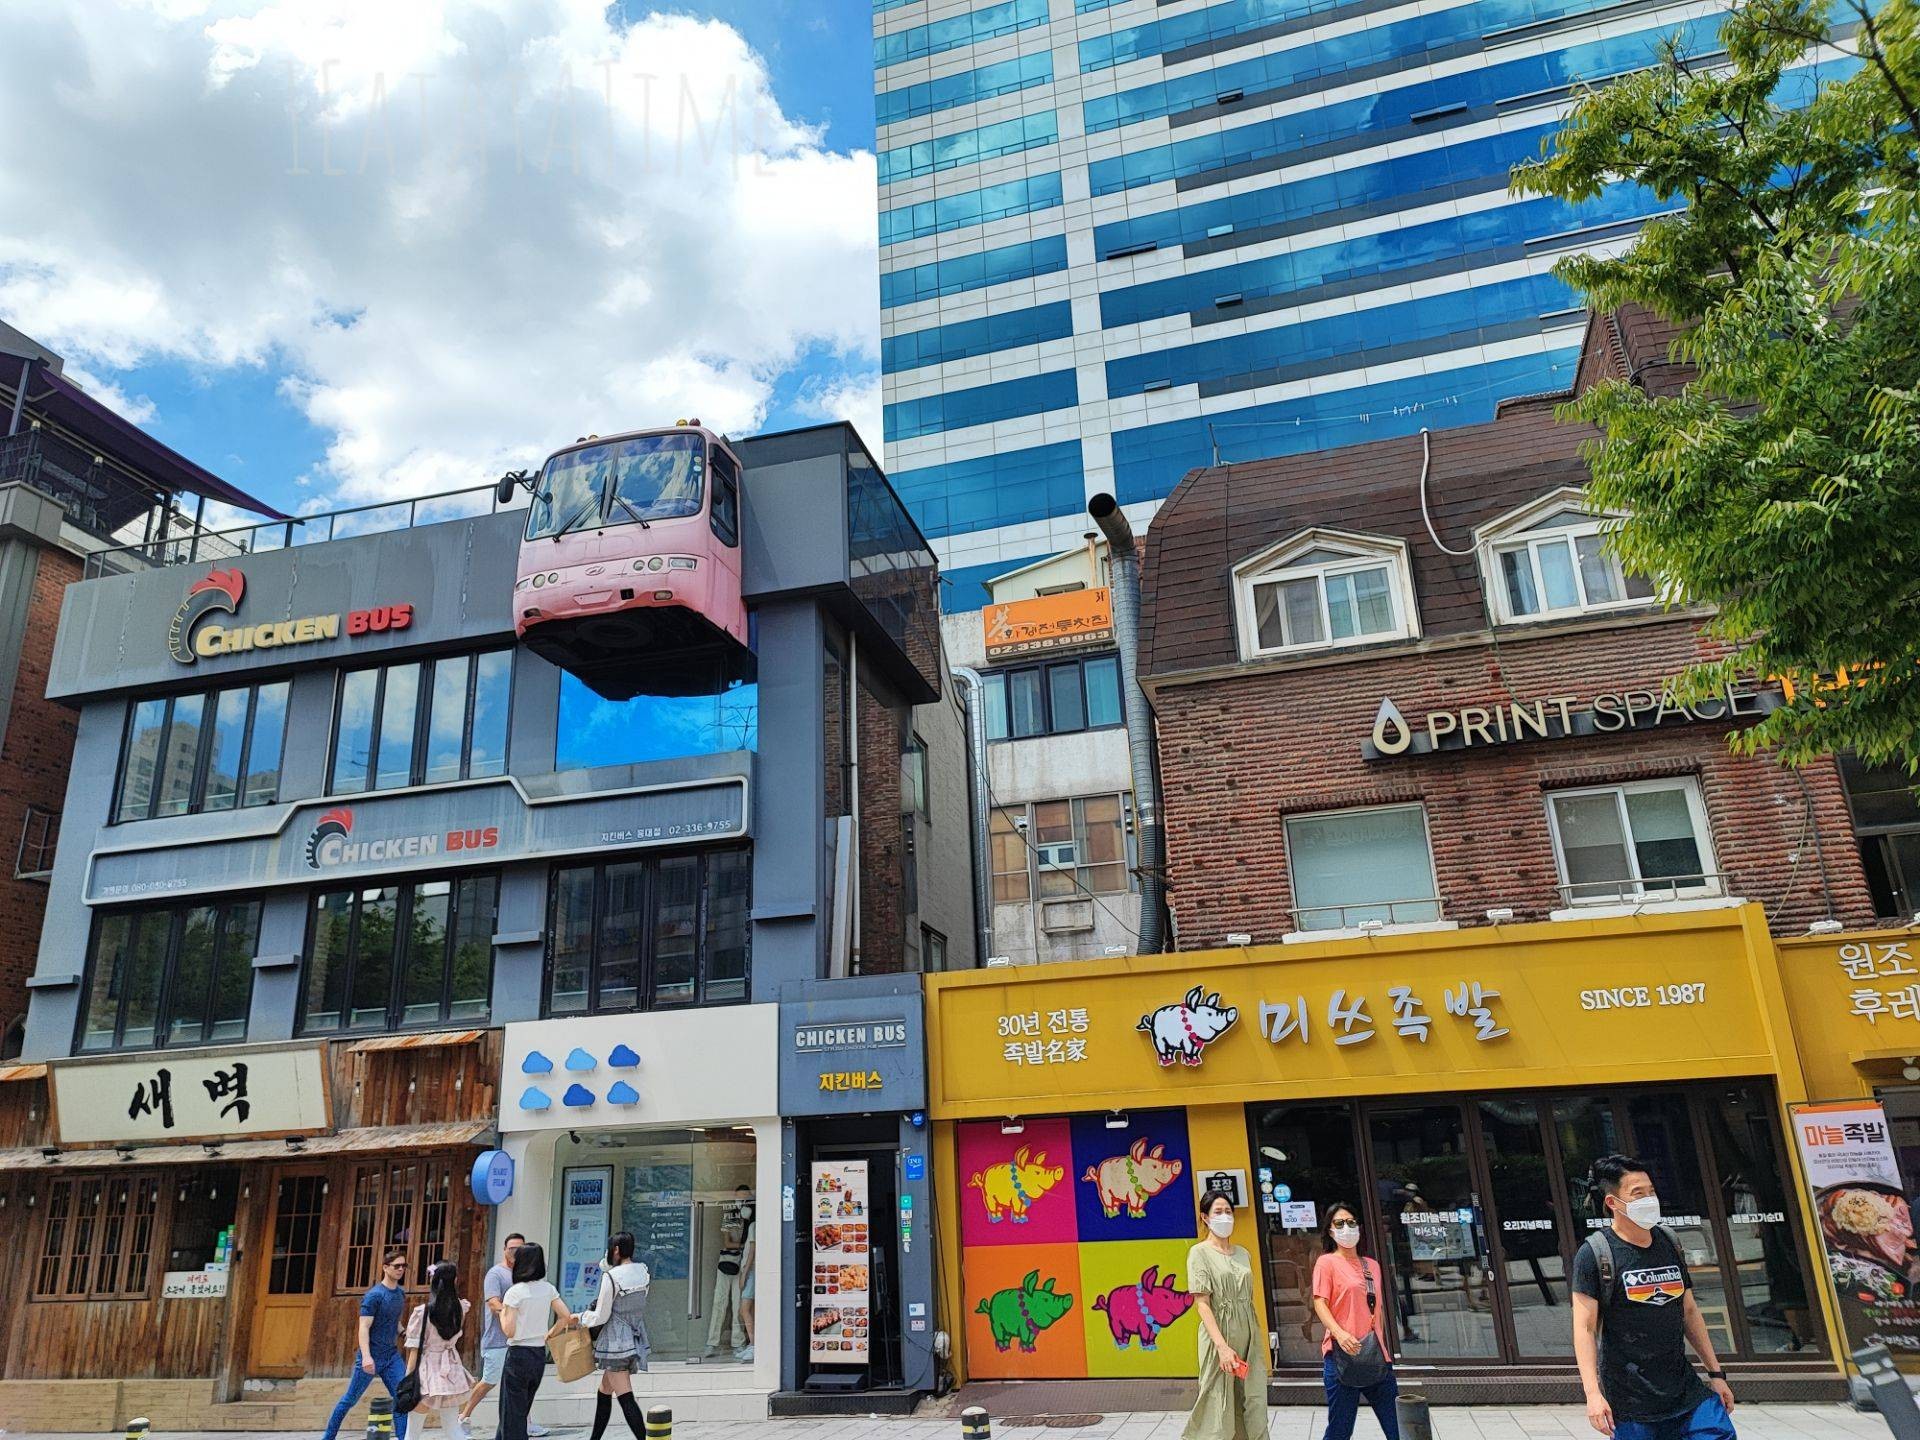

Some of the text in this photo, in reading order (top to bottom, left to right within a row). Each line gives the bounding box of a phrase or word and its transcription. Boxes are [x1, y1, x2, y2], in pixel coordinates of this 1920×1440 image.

[196, 603, 413, 657] CHICKEN BUS
[1426, 696, 1577, 750] PRINT
[668, 820, 731, 835] 02-336-9755
[319, 827, 498, 866] CHICKEN BUS
[1838, 942, 1920, 979] 원조
[1580, 983, 1706, 1010] SINCE 1987
[796, 1024, 906, 1047] CHICKEN BUS
[998, 1008, 1090, 1037] 30년 전통
[1003, 1038, 1088, 1066] 족발名家
[128, 1062, 250, 1128] 새벽
[1804, 1121, 1885, 1146] 마늘족발
[1211, 1179, 1232, 1191] 포장
[1400, 1211, 1459, 1224] 원조마늘족발
[1638, 1269, 1681, 1284] Columbia
